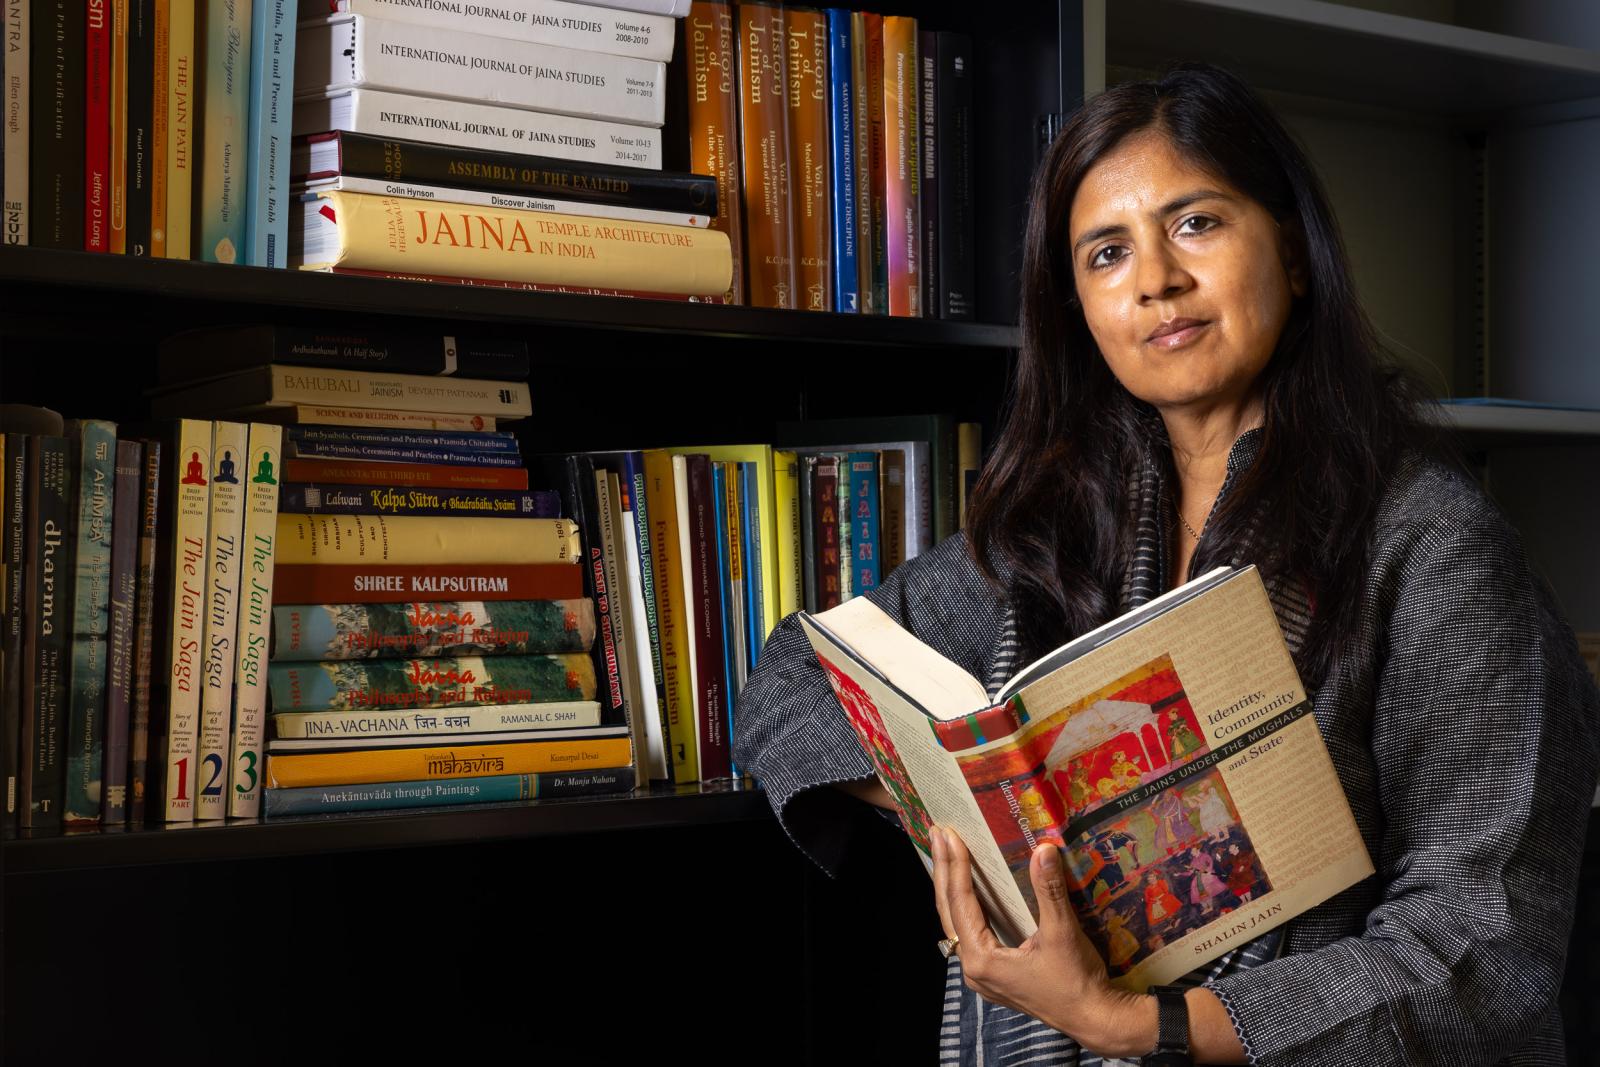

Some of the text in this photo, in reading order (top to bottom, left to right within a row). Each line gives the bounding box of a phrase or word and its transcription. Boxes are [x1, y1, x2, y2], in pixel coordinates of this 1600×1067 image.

[615, 22, 651, 34] Volume 4-6
[615, 34, 649, 46] 2008-2010
[380, 42, 606, 88] INTERNATIONAL JOURNAL OF JAINA STUDIES
[693, 17, 713, 104] Jainism
[709, 52, 720, 69] of
[720, 13, 732, 93] History
[748, 20, 764, 104] Jainism
[762, 54, 772, 71] of
[771, 16, 786, 96] History
[787, 26, 807, 109] Jainism
[803, 60, 813, 75] of
[812, 20, 827, 101] History
[10, 76, 19, 134] Ellen Gough
[175, 56, 187, 170] THE JAIN PATH
[858, 83, 869, 160] SPIRITUAL
[923, 57, 935, 180] JAIN STUDIES IN CANADA
[379, 112, 596, 151] INTERNATIONAL JOURNAL OF JAINA STUDIES
[268, 136, 278, 181] Lawrence
[447, 160, 630, 194] ASSEMBLY OF THE EXALTED
[615, 151, 648, 161] 2014-2017
[842, 81, 854, 258] SALVATION THROUGH SELF-DISCIPLINE
[220, 142, 232, 222] Acharya Mahaprajna
[267, 184, 276, 195] A.
[385, 184, 435, 199] Colin Hynson
[804, 142, 814, 218] Medieval Jainism
[860, 167, 871, 236] INSIGHTS
[90, 171, 102, 247] Jeffery D Long
[266, 198, 276, 223] Babb
[490, 195, 556, 212] Discover Jainism
[415, 210, 535, 254] JAINA
[535, 220, 694, 249] TEMPLE ARCHITECTURE
[539, 241, 596, 260] IN INDIA
[284, 375, 362, 394] BAHUBALI
[370, 386, 404, 399] JAINISM
[408, 386, 489, 400] DEVDUTT PATTANAIK
[316, 410, 345, 420] SCIENCE
[347, 411, 364, 420] AND
[364, 411, 399, 422] RELIGION
[304, 429, 318, 440] Jain
[351, 432, 390, 443] Ceremonies
[390, 434, 404, 443] and
[404, 434, 434, 445] Practices
[439, 437, 467, 448] Pramoda
[467, 438, 508, 449] Chitrabhanu
[12, 456, 24, 562] Understanding Jainism
[90, 467, 104, 543] AHIMSA
[144, 454, 157, 531] LIFE FORCE
[325, 491, 363, 506] Lalwani
[370, 487, 407, 512] Kalpa
[408, 490, 439, 509] Sūtra
[448, 494, 494, 511] Bhadrabāhu
[920, 463, 930, 529] GANDHI
[183, 537, 204, 578] The
[214, 534, 235, 576] The
[250, 532, 273, 574] The
[599, 479, 623, 645] ECONOMICS OF LORD MAHAVIRA
[41, 519, 62, 637] dharma
[352, 576, 508, 593] SHREE KALPSUTRAM
[633, 473, 663, 685] PHILOSOPHICAL FOUNDATIONS OF JAINISM
[655, 519, 676, 642] Fundamentals
[179, 581, 200, 630] Jain
[210, 578, 232, 628] Jain
[247, 577, 270, 627] Jain
[408, 602, 475, 628] Jaina
[289, 612, 301, 651] SHAH
[346, 628, 530, 652] Philosophy and Religion
[591, 547, 623, 709] A VISIT TO SHATRUNJAYA
[665, 641, 677, 658] of
[173, 635, 198, 693] Saga
[204, 634, 229, 691] Saga
[240, 632, 266, 688] Saga
[408, 659, 477, 685] Jaina
[289, 671, 300, 707] SHAH
[347, 685, 532, 709] Philosophy and Religion
[664, 661, 682, 726] Jainism
[1207, 690, 1266, 726] Identity,
[304, 716, 407, 738] JINA-VACHANA
[413, 714, 471, 733] जिन-वचन
[1213, 690, 1296, 740] Community
[199, 753, 224, 796] 2
[235, 750, 258, 794] 3
[426, 753, 505, 775] mahavira
[549, 752, 599, 765] Kumarpal Desai
[1117, 707, 1304, 809] THE JAINS UNDER THE MUGHALS
[1228, 736, 1284, 771] and State
[172, 756, 189, 802] 1
[319, 784, 481, 806] Anekāntavāda through Paintings
[553, 775, 617, 791] Dr. Manju Nahata
[1194, 904, 1283, 956] SHALIN JAIN
